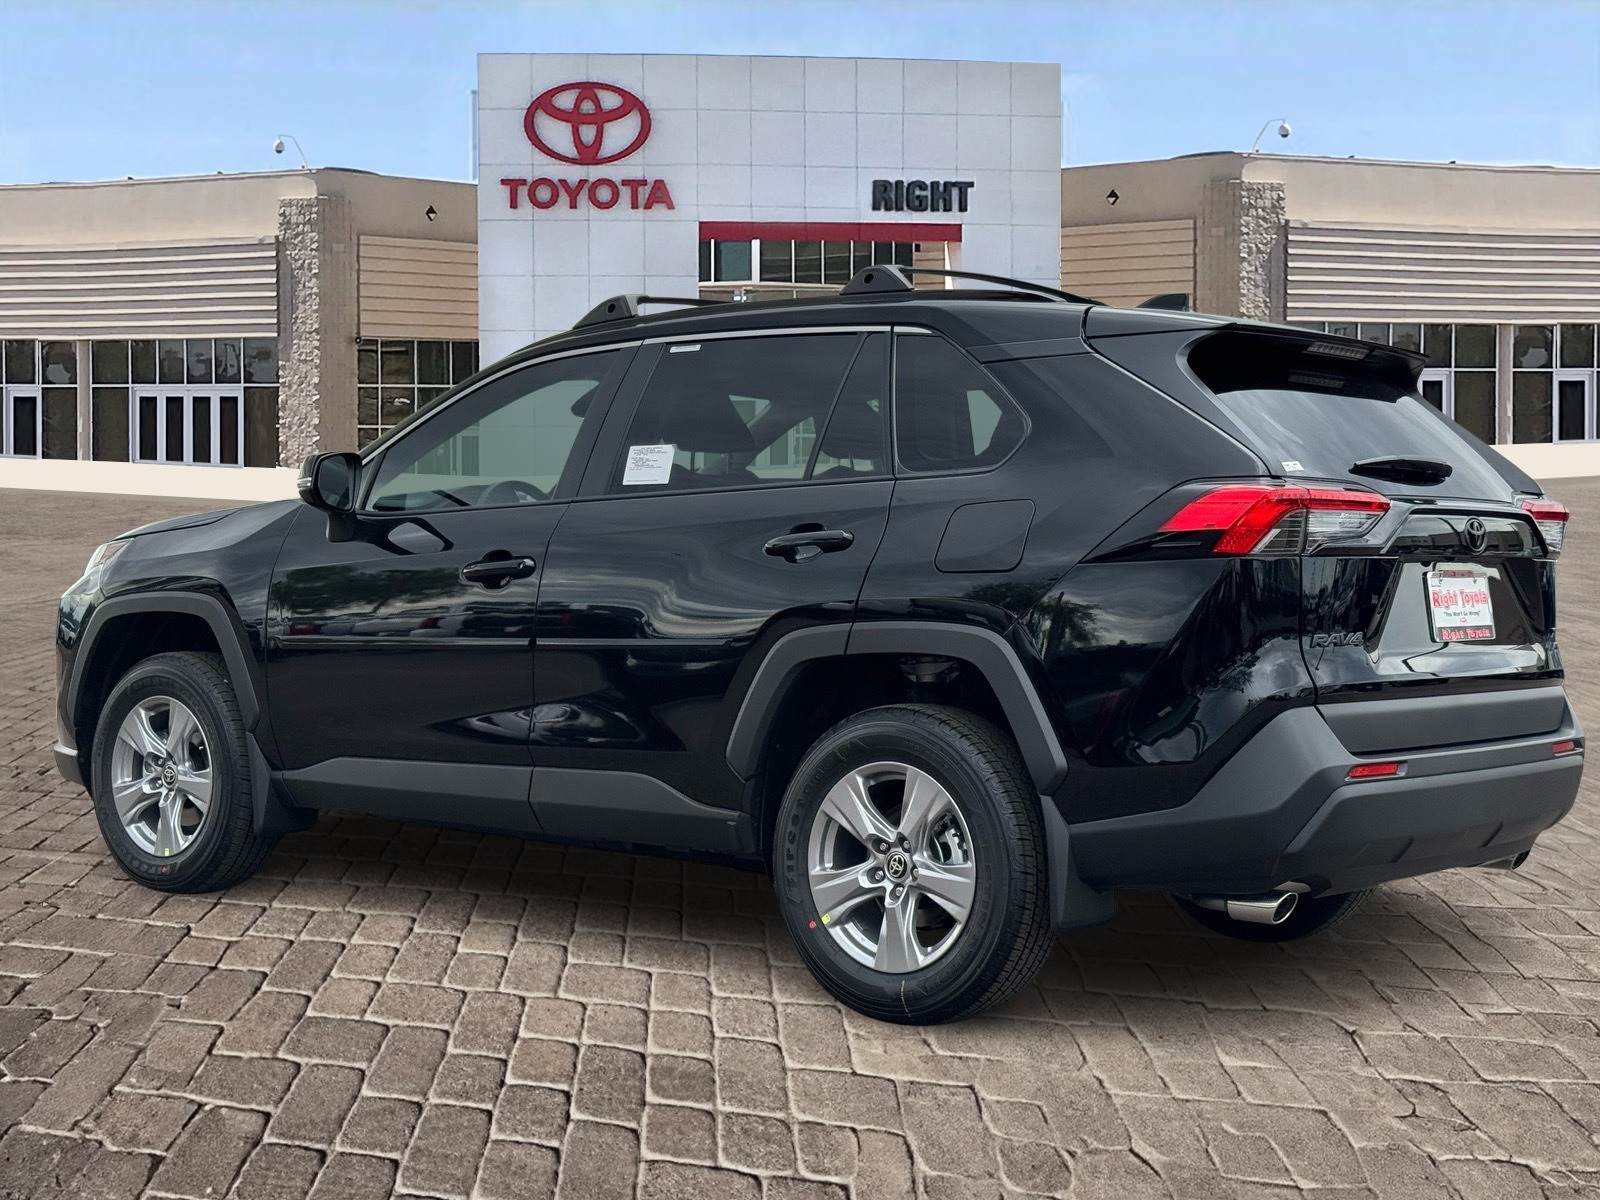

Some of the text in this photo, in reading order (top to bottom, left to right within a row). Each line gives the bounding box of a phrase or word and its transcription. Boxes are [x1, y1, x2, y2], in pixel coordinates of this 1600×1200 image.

[500, 178, 675, 210] TOYOTA
[871, 180, 975, 212] RIGHT
[1432, 589, 1488, 609] Right Toyota
[1309, 631, 1364, 648] RAV4
[1442, 628, 1490, 640] Right Toyota
